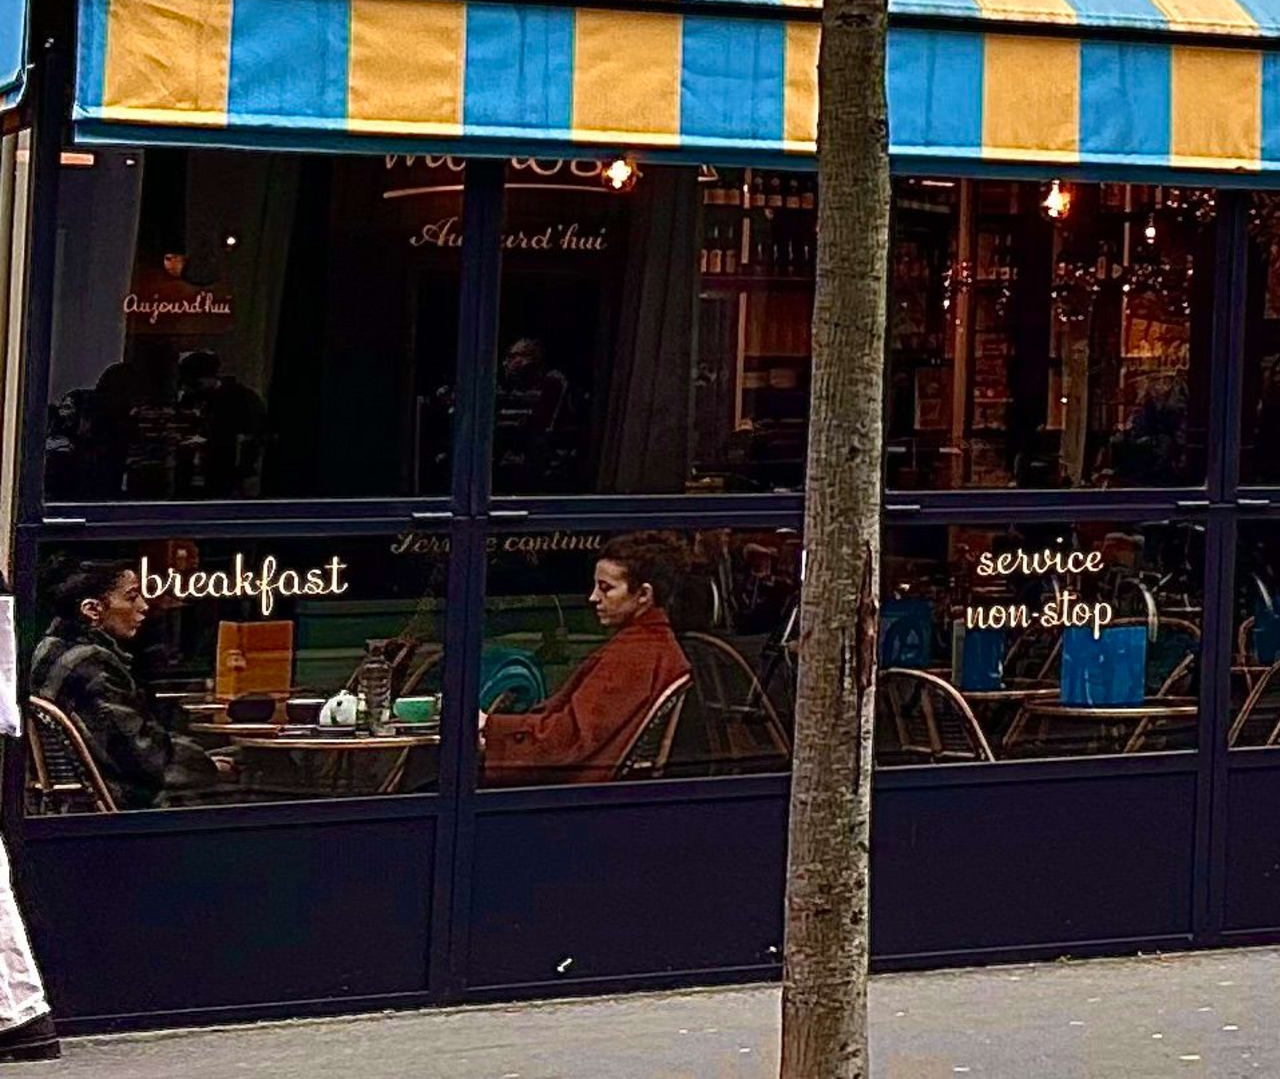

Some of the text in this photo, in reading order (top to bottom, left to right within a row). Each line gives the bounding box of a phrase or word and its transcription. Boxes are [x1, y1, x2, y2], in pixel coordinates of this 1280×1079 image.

[123, 291, 231, 324] Aujourd'hui
[976, 537, 1104, 576] service
[141, 552, 349, 616] breakfast
[966, 590, 1112, 640] non-stop
